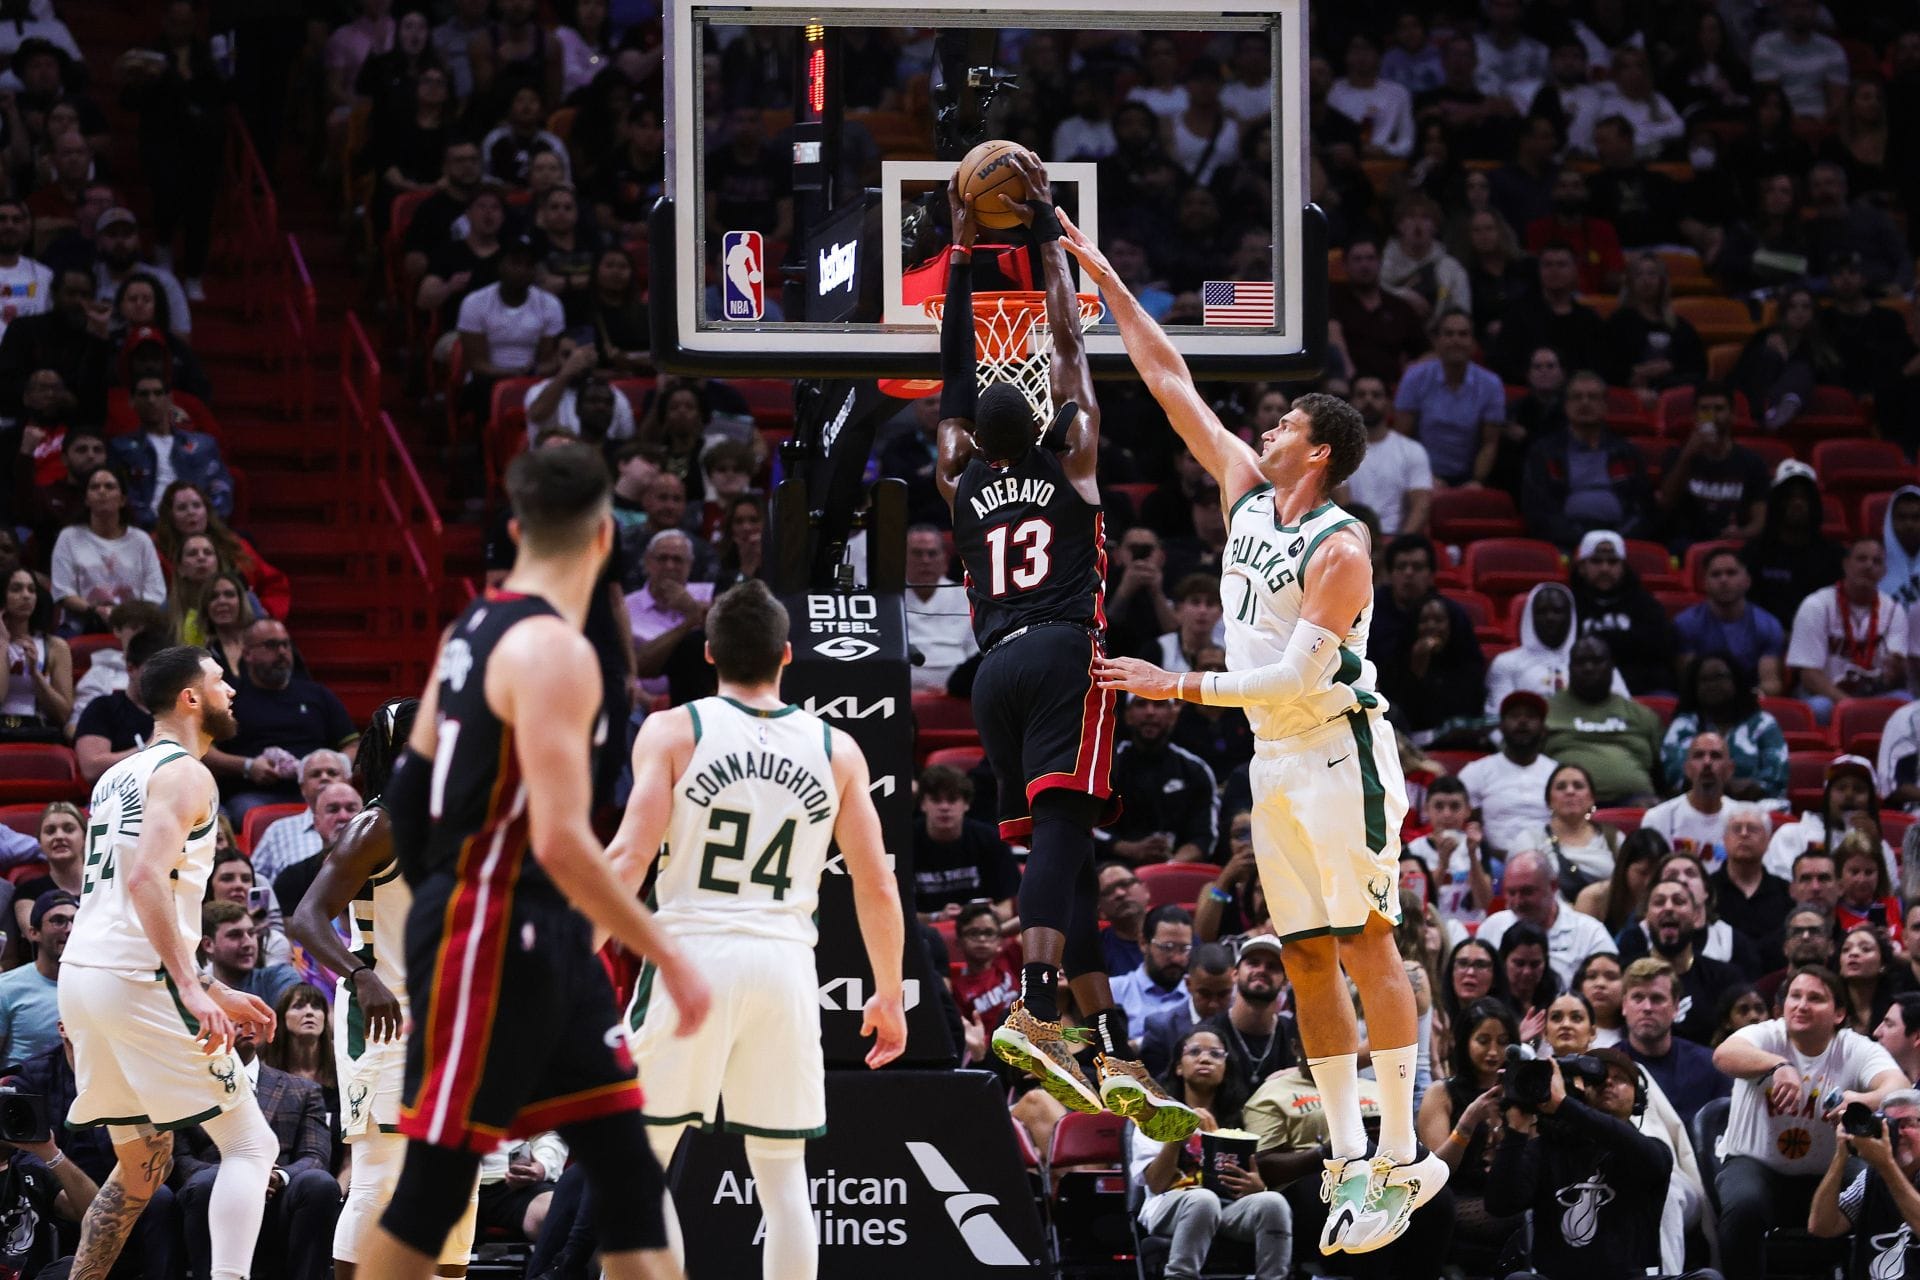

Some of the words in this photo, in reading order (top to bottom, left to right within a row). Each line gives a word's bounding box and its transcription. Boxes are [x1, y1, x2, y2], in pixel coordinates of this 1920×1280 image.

[730, 300, 749, 315] NBA
[970, 477, 1055, 520] ADEBAYO
[985, 517, 1053, 597] 13
[808, 595, 877, 620] BIO
[810, 621, 879, 633] STEEL
[685, 751, 831, 825] CONNAUGHTON
[698, 808, 797, 901] 24
